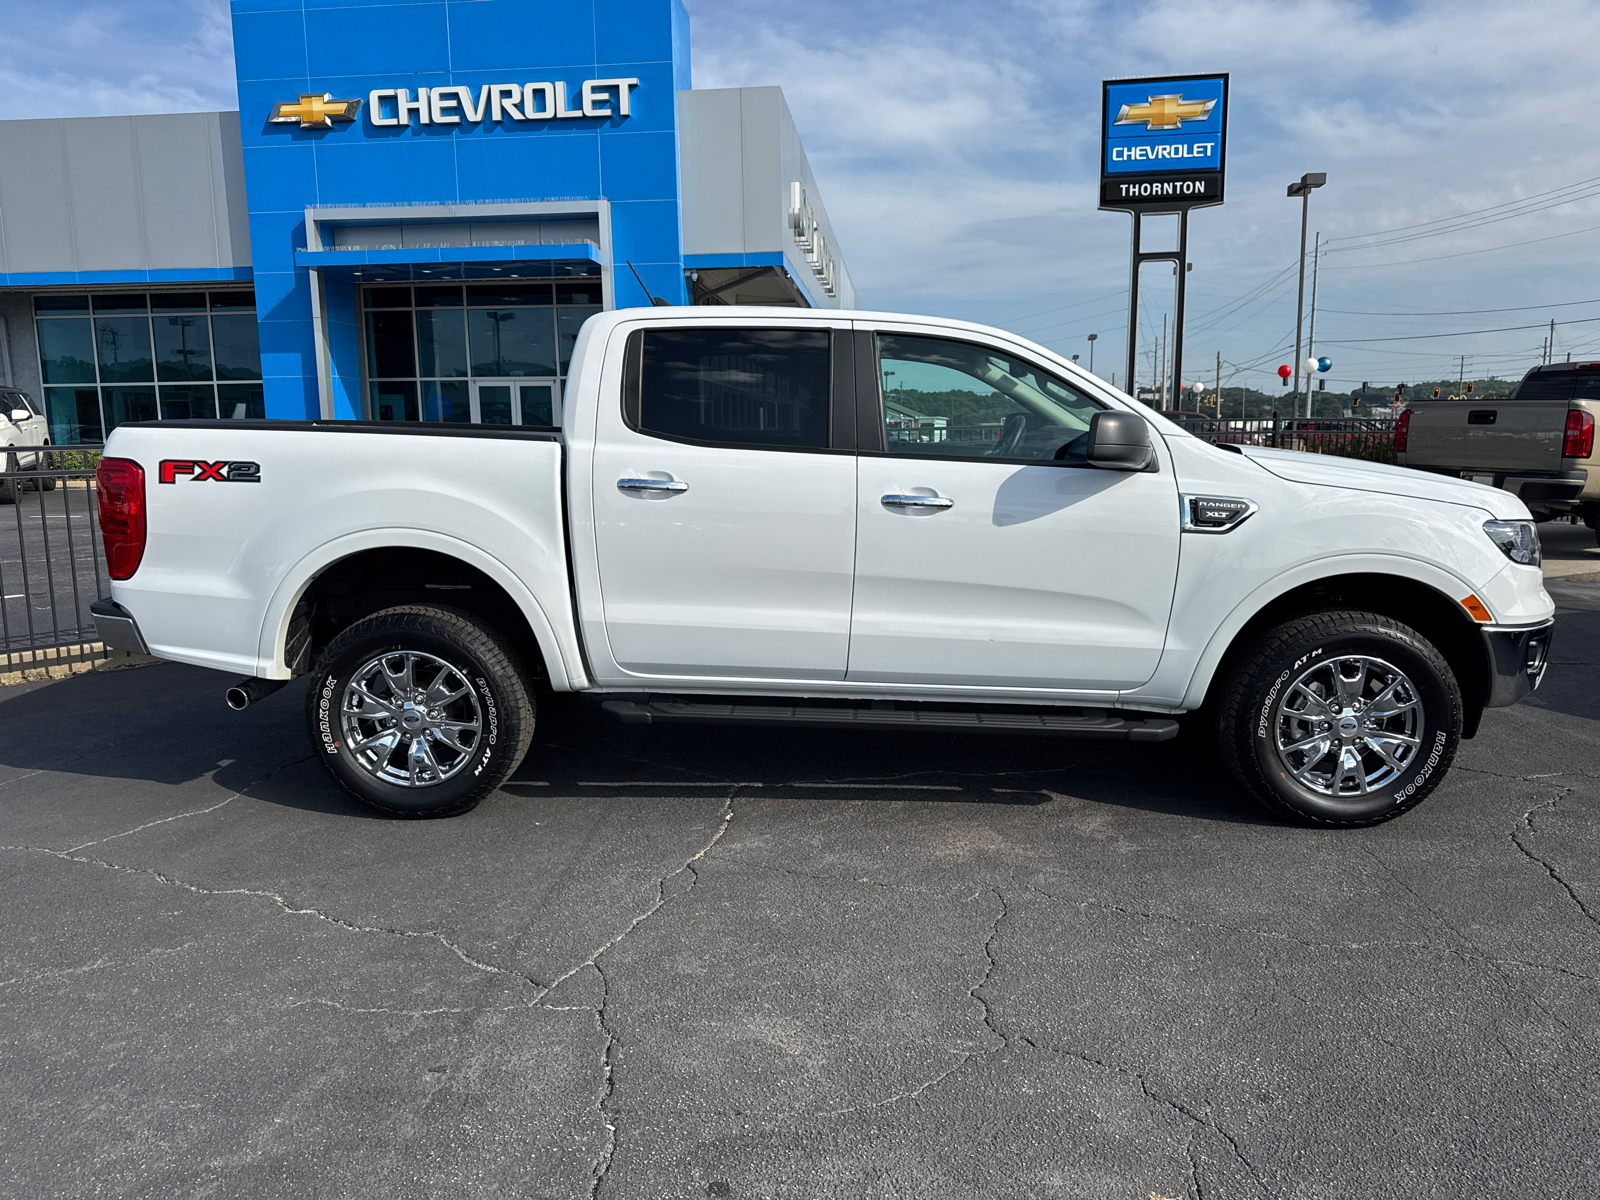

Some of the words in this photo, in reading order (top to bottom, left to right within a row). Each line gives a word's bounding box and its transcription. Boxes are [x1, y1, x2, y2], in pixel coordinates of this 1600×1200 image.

[369, 77, 640, 126] CHEVROLET
[1112, 142, 1215, 161] CHEVROLET
[1120, 181, 1205, 197] THORNTON
[158, 459, 261, 485] FX2
[1199, 501, 1246, 509] RANGER
